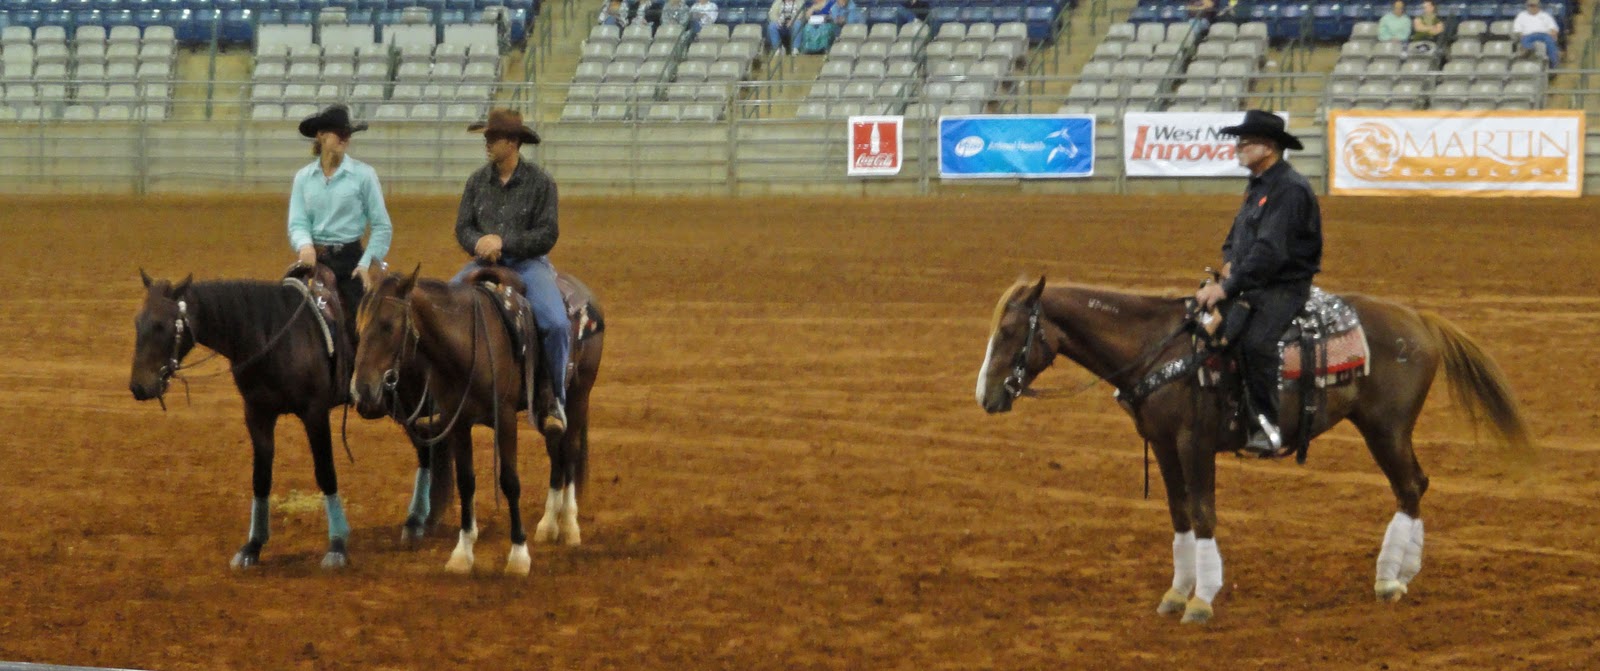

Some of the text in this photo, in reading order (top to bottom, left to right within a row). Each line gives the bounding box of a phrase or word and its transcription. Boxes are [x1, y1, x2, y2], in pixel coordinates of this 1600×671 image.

[1131, 125, 1236, 161] Innova
[1154, 126, 1238, 141] West Ni
[1401, 129, 1570, 163] MARTIN
